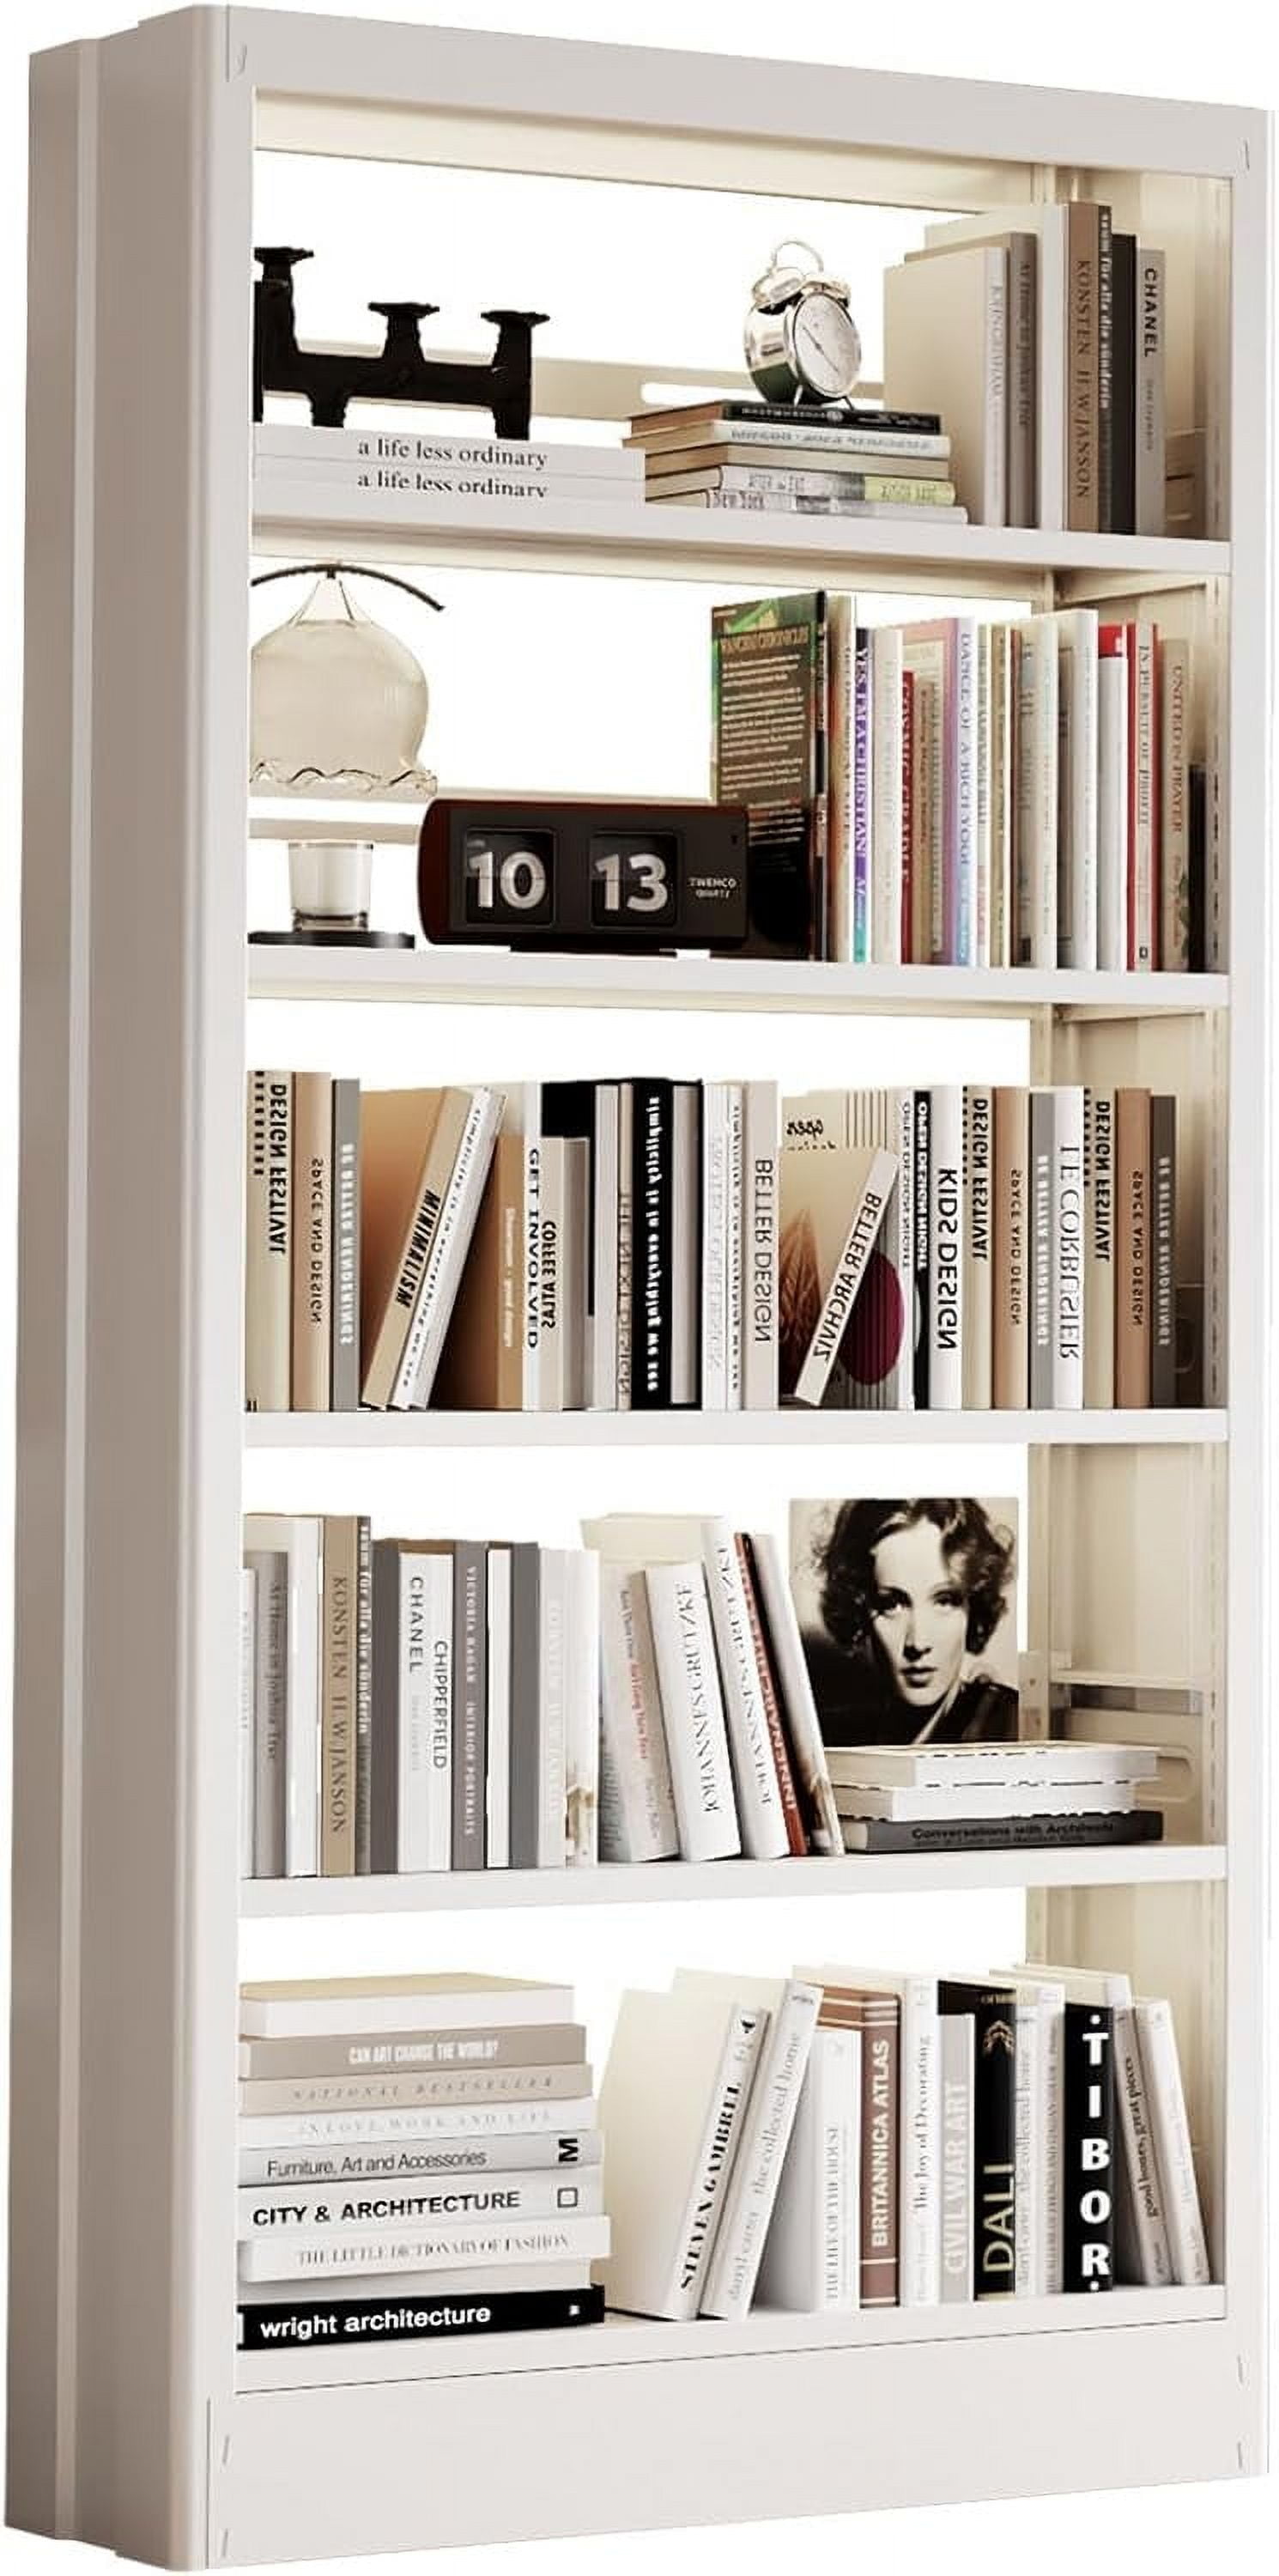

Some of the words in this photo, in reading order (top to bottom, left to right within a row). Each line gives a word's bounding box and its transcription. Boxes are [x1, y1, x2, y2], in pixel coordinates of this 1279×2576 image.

[1143, 268, 1157, 358] CHANEL
[358, 443, 369, 456] a
[377, 439, 409, 459] life
[416, 442, 452, 461] less
[459, 446, 548, 471] ordinary
[358, 476, 369, 487] a
[377, 471, 409, 491] life
[416, 475, 452, 494] less
[459, 478, 548, 498] ordinary
[468, 851, 547, 909] 10
[595, 853, 668, 912] 13
[528, 1148, 540, 1200] GET
[396, 1189, 440, 1309] MINIMALISM
[528, 1208, 540, 1349] INVOLVED
[409, 1577, 424, 1674] CHANEL
[433, 1641, 448, 1769] CHIPPERFIELD
[871, 2039, 890, 2107] ATLAS
[342, 2155, 362, 2172] Art
[366, 2154, 395, 2170] and
[398, 2150, 488, 2169] Accessories
[871, 2113, 890, 2246] BRITANNICA
[252, 2206, 307, 2226] CITY
[315, 2204, 330, 2223] &
[342, 2191, 521, 2221] ARCHITECTURE
[983, 2163, 1015, 2272] DALI
[260, 2316, 338, 2340] wright
[343, 2306, 491, 2334] architecture
